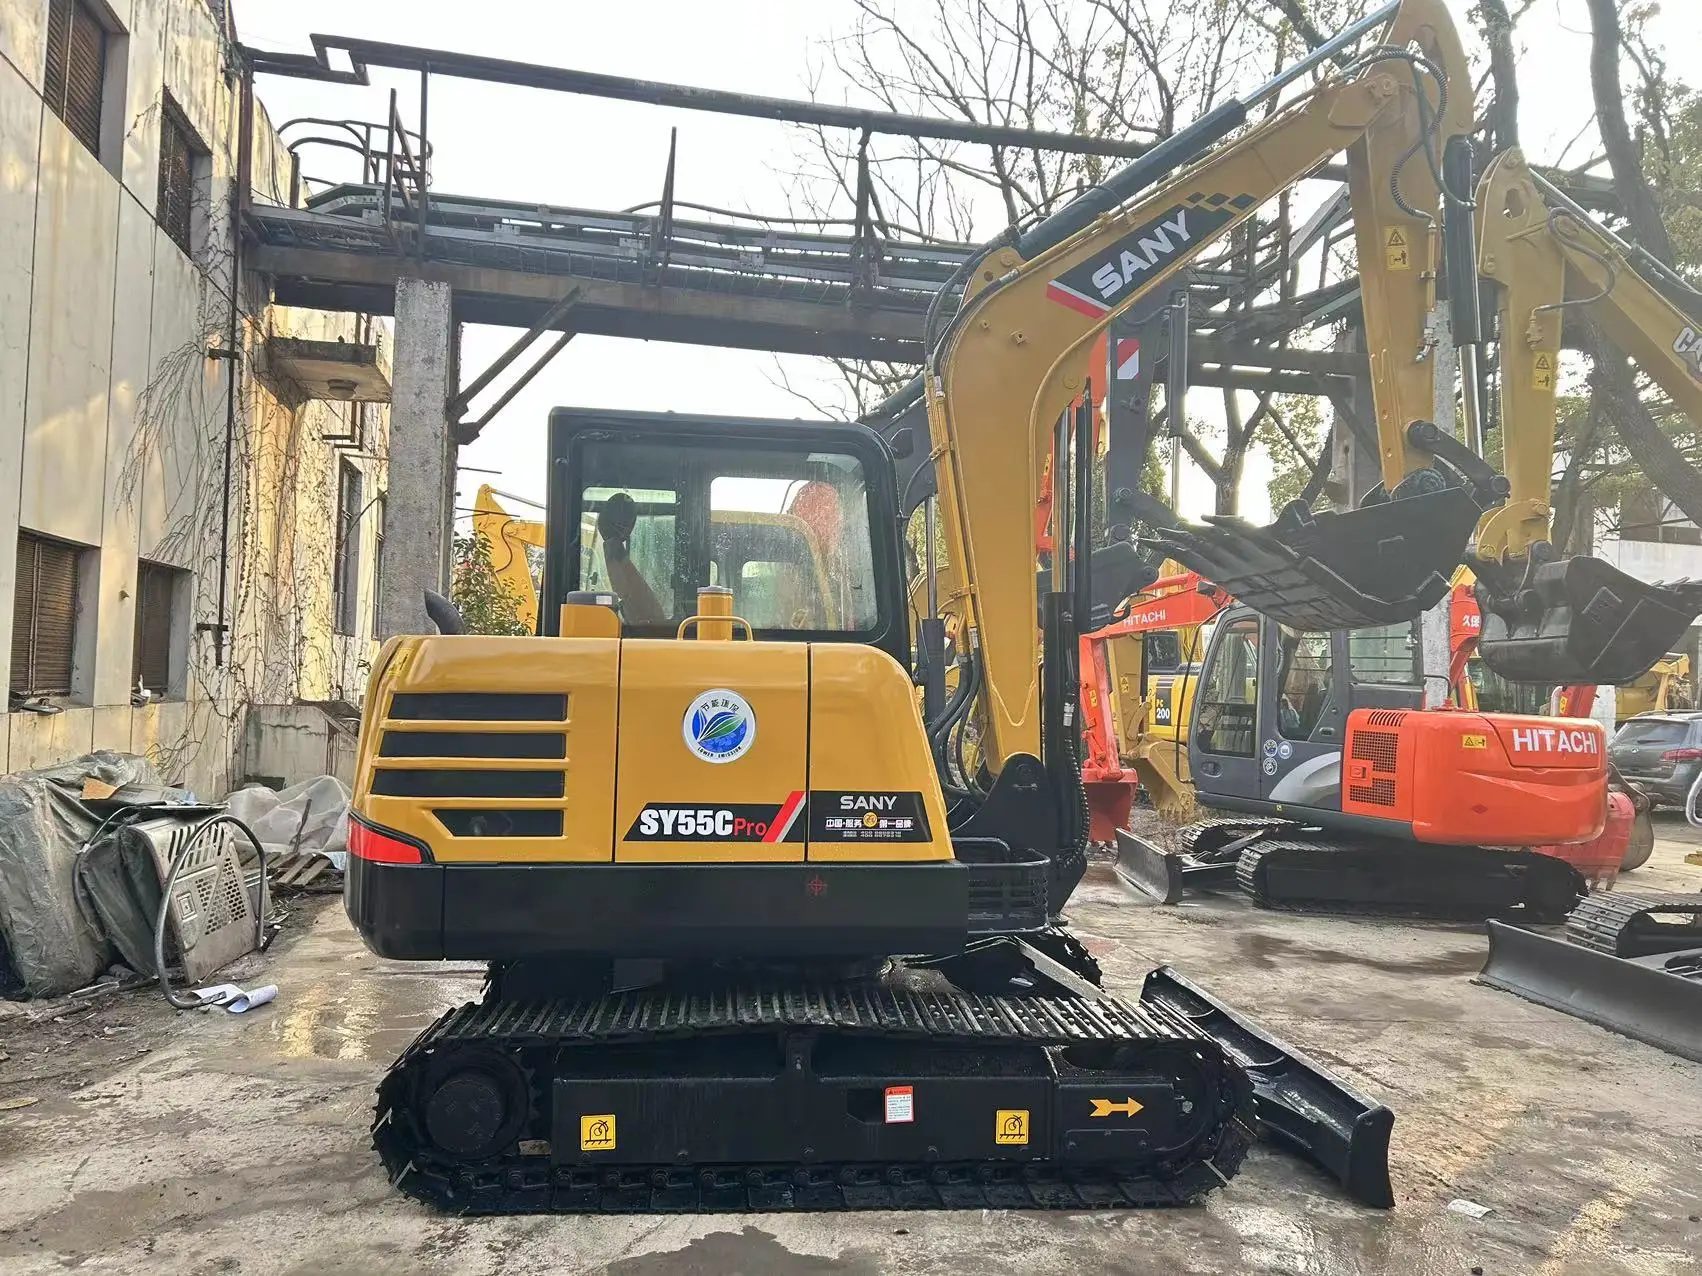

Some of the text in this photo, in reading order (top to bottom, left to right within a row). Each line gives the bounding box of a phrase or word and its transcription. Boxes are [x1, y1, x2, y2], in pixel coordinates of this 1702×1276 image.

[1092, 209, 1191, 299] SANY
[1123, 609, 1166, 626] HITACHI
[1156, 707, 1170, 719] 200
[1512, 728, 1598, 754] HITACHI
[840, 795, 898, 810] SANY
